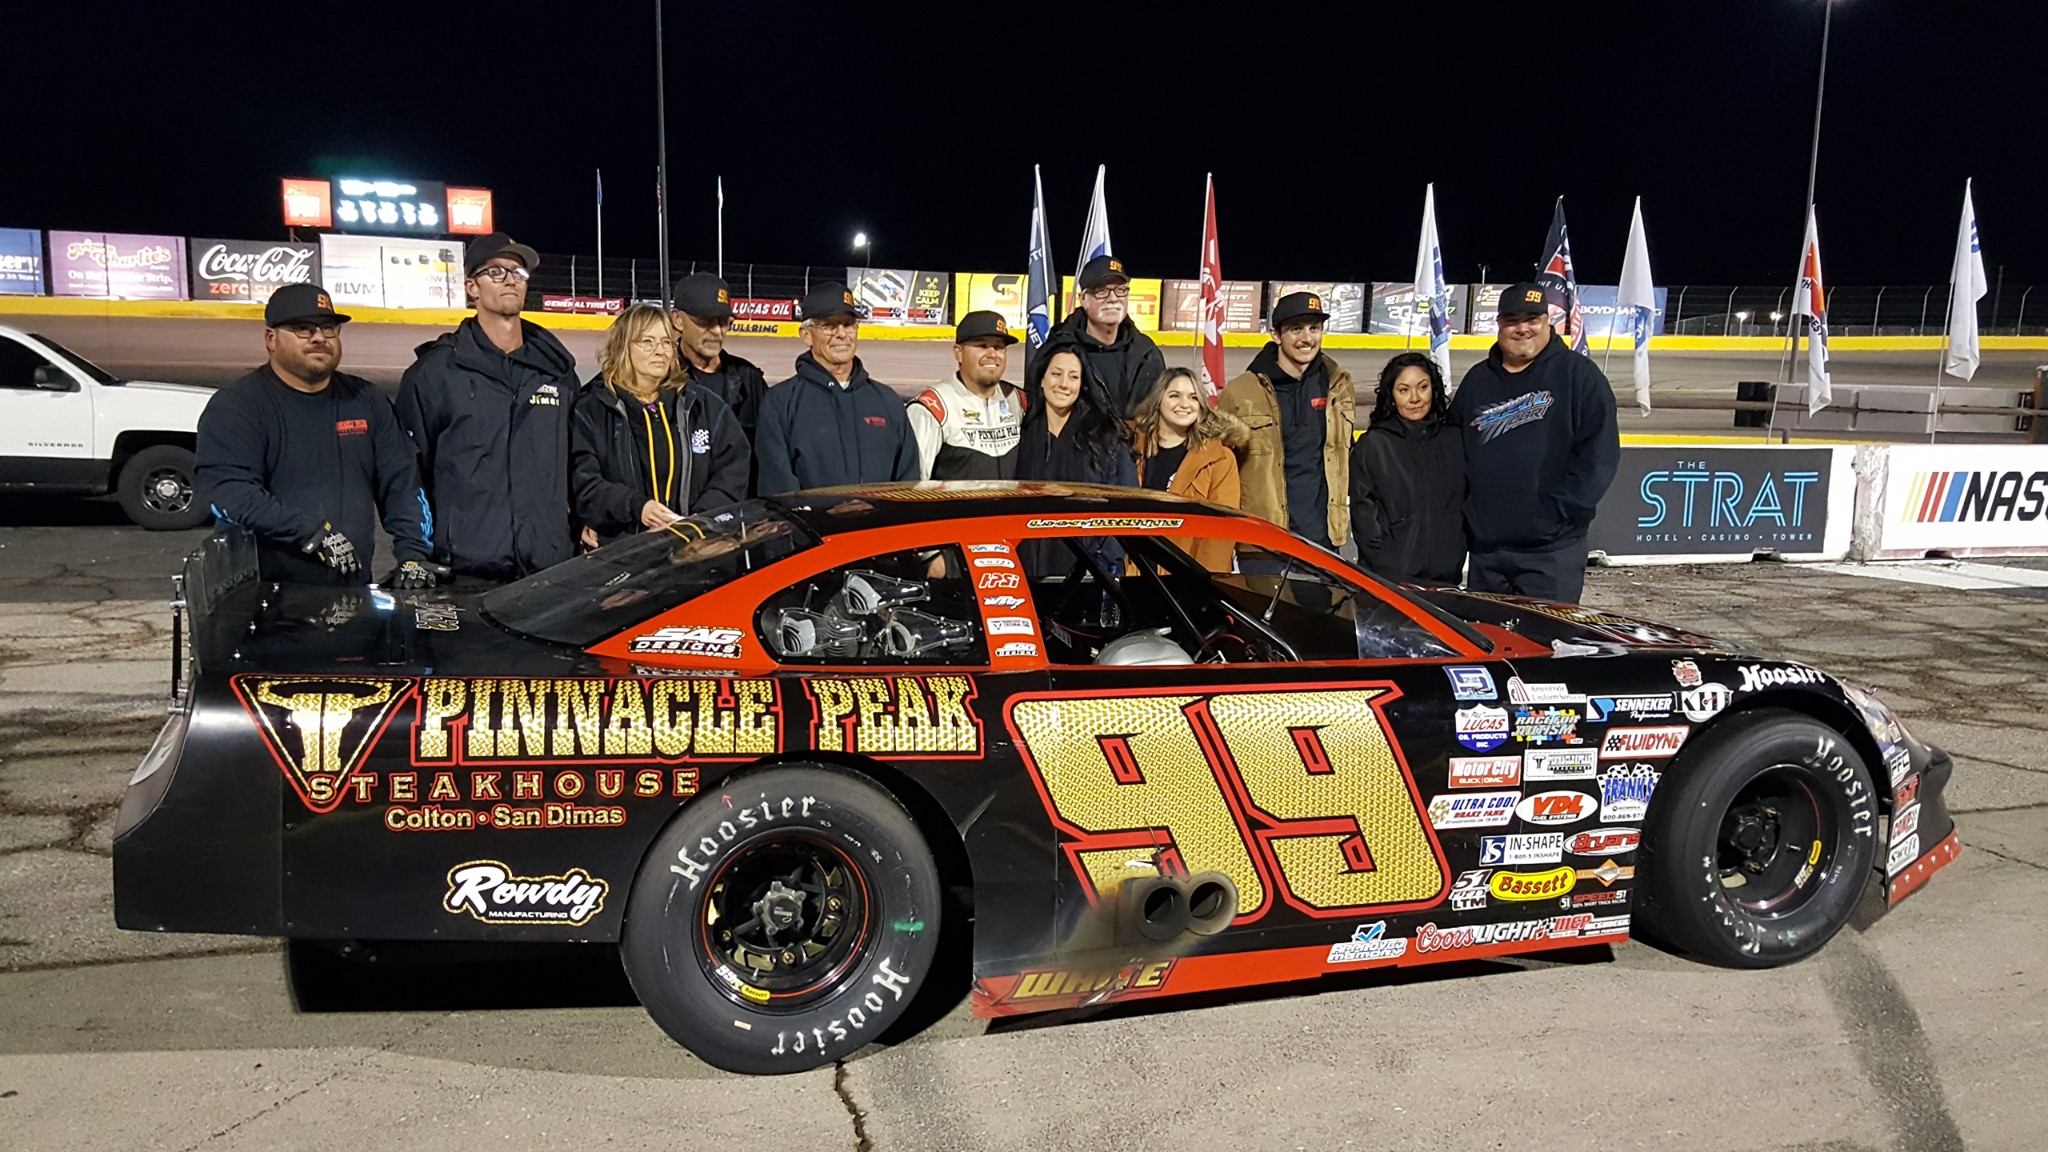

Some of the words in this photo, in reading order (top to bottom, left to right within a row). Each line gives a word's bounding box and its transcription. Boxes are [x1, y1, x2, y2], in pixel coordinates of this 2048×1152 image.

[915, 297, 939, 305] CALM
[918, 289, 940, 297] KEEP
[1525, 290, 1543, 303] 99
[732, 302, 770, 314] LUCAS
[771, 303, 790, 315] OIL
[1677, 460, 1706, 470] THE
[1637, 471, 1819, 528] STRAT
[1636, 533, 1678, 542] HOTEL
[1701, 533, 1751, 542] CASINO
[1772, 532, 1814, 541] TOWER
[635, 627, 742, 644] SAG
[635, 641, 736, 653] DESIGNS
[1738, 665, 1826, 692] Hoosier
[1614, 698, 1672, 711] SENNEKER
[421, 679, 775, 756] PINNACLE
[811, 676, 977, 752] PEAK
[1462, 719, 1506, 731] LUCAS
[1515, 724, 1573, 736] AUTISM
[1619, 733, 1678, 751] FLUIDYNE
[1452, 760, 1488, 777] Motor
[1491, 759, 1518, 779] City
[308, 770, 699, 801] STEAKHOUSE
[1804, 736, 1872, 837] Hoosier
[1004, 684, 1450, 922] 99
[1451, 798, 1486, 810] ULTRA
[1488, 796, 1517, 808] COOL
[387, 806, 472, 829] Colton
[493, 805, 540, 827] San
[547, 805, 624, 827] Dimas
[670, 792, 816, 890] Hoosier
[1509, 834, 1562, 850] IN-SHAPE
[1452, 870, 1491, 890] 51
[1499, 871, 1568, 895] Bassett
[451, 866, 602, 920] Rowdy
[1454, 898, 1485, 909] LTM
[1560, 897, 1571, 908] 51
[488, 910, 568, 919] MANUFACTURING
[1553, 915, 1593, 931] MEP
[1416, 922, 1474, 952] Coors
[1475, 920, 1538, 943] LIGHT
[770, 956, 911, 1056] Hoosier
